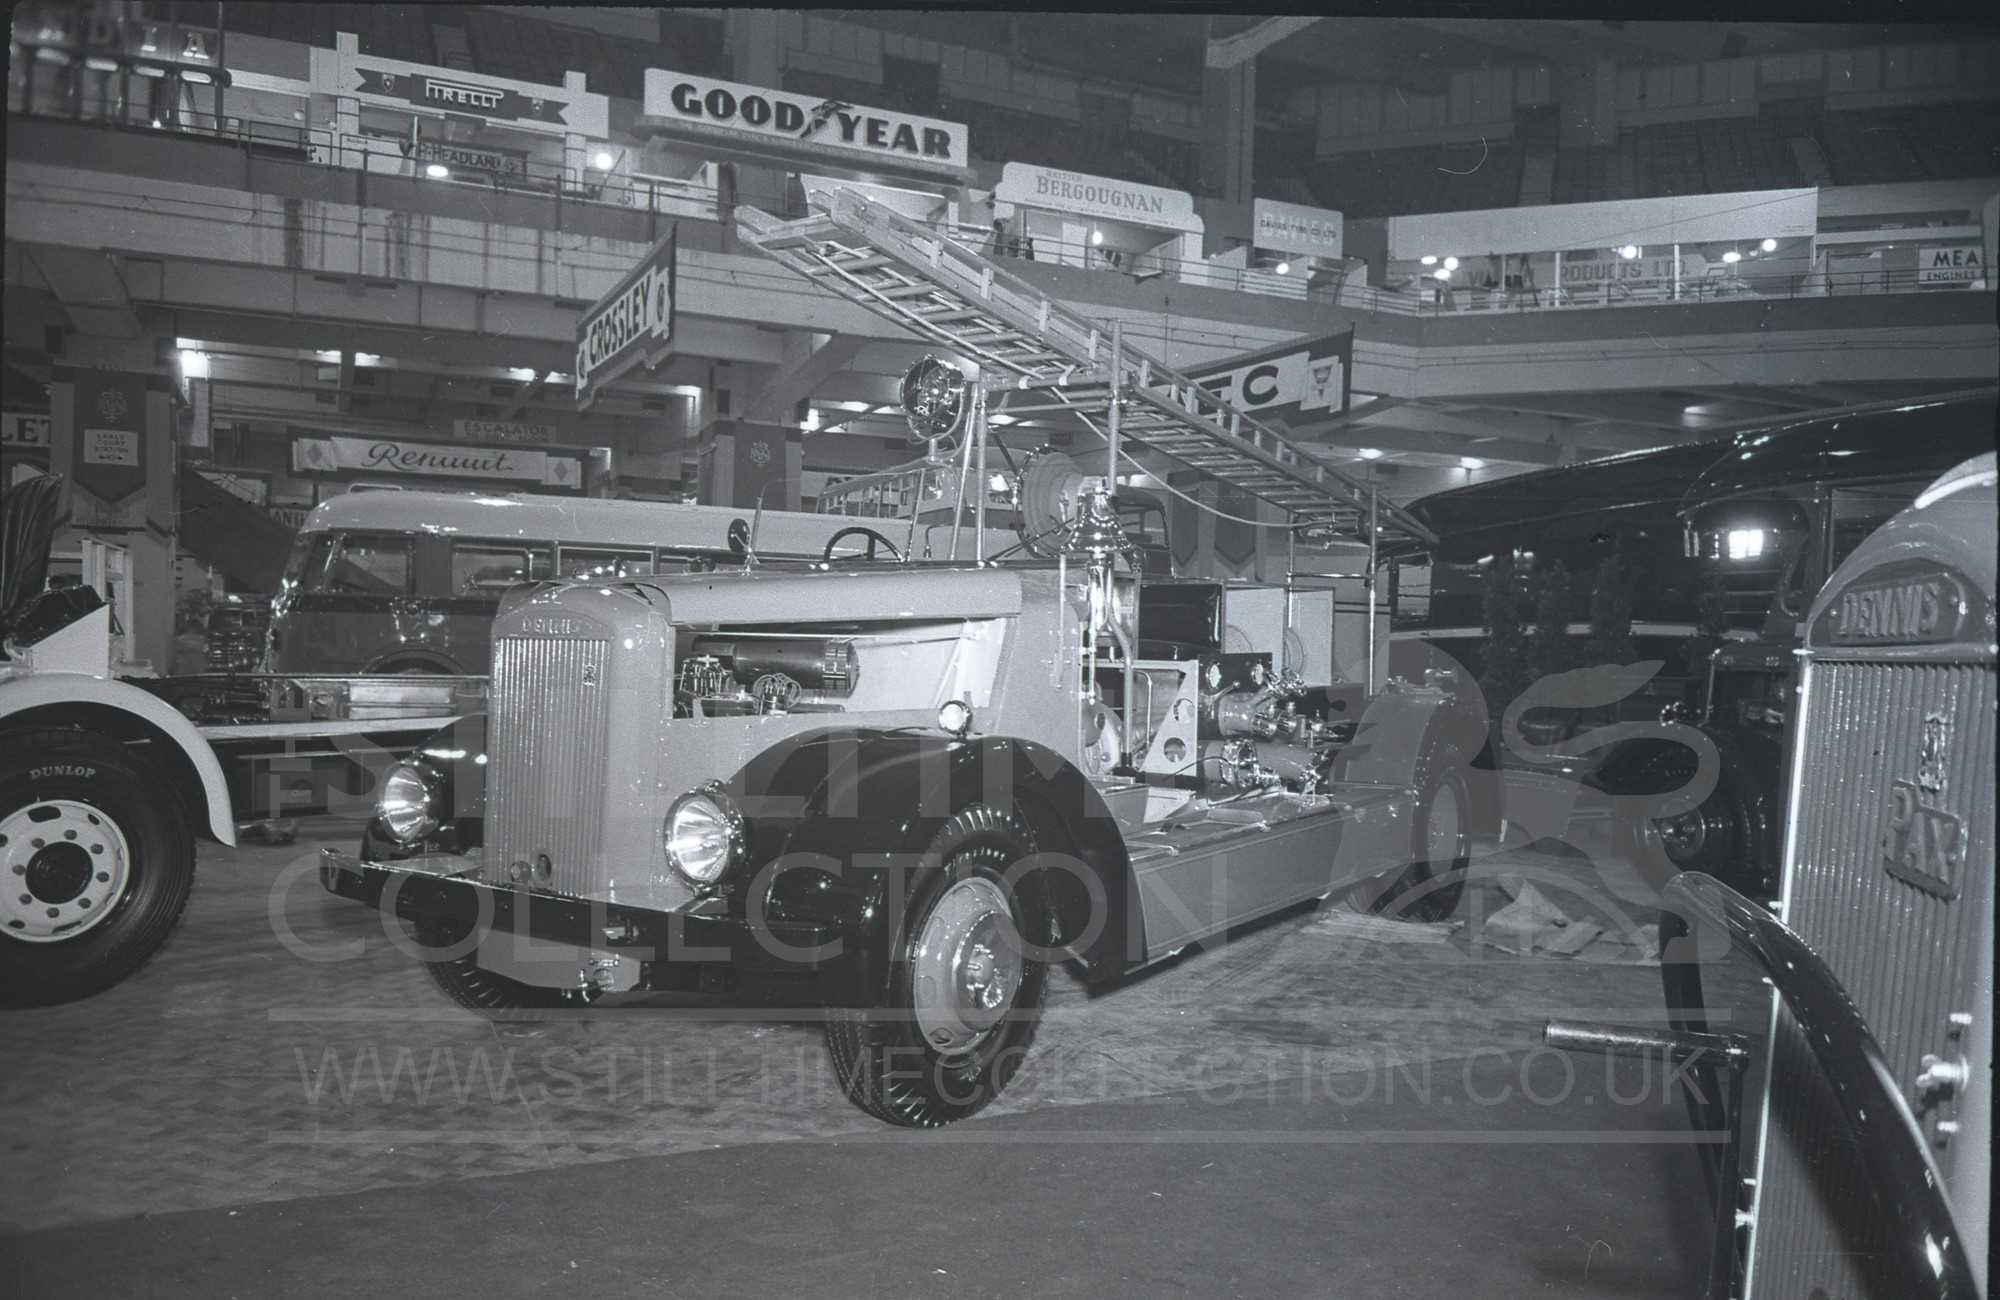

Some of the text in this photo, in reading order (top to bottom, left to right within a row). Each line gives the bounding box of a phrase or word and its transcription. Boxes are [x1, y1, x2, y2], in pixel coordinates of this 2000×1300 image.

[426, 79, 504, 109] PIRELLI
[1036, 176, 1163, 214] BERGOUGNAN
[589, 272, 650, 366] CROSSLEY
[361, 442, 513, 472] Renault
[1838, 582, 1940, 637] DENNIS
[29, 765, 96, 780] DUNLOP
